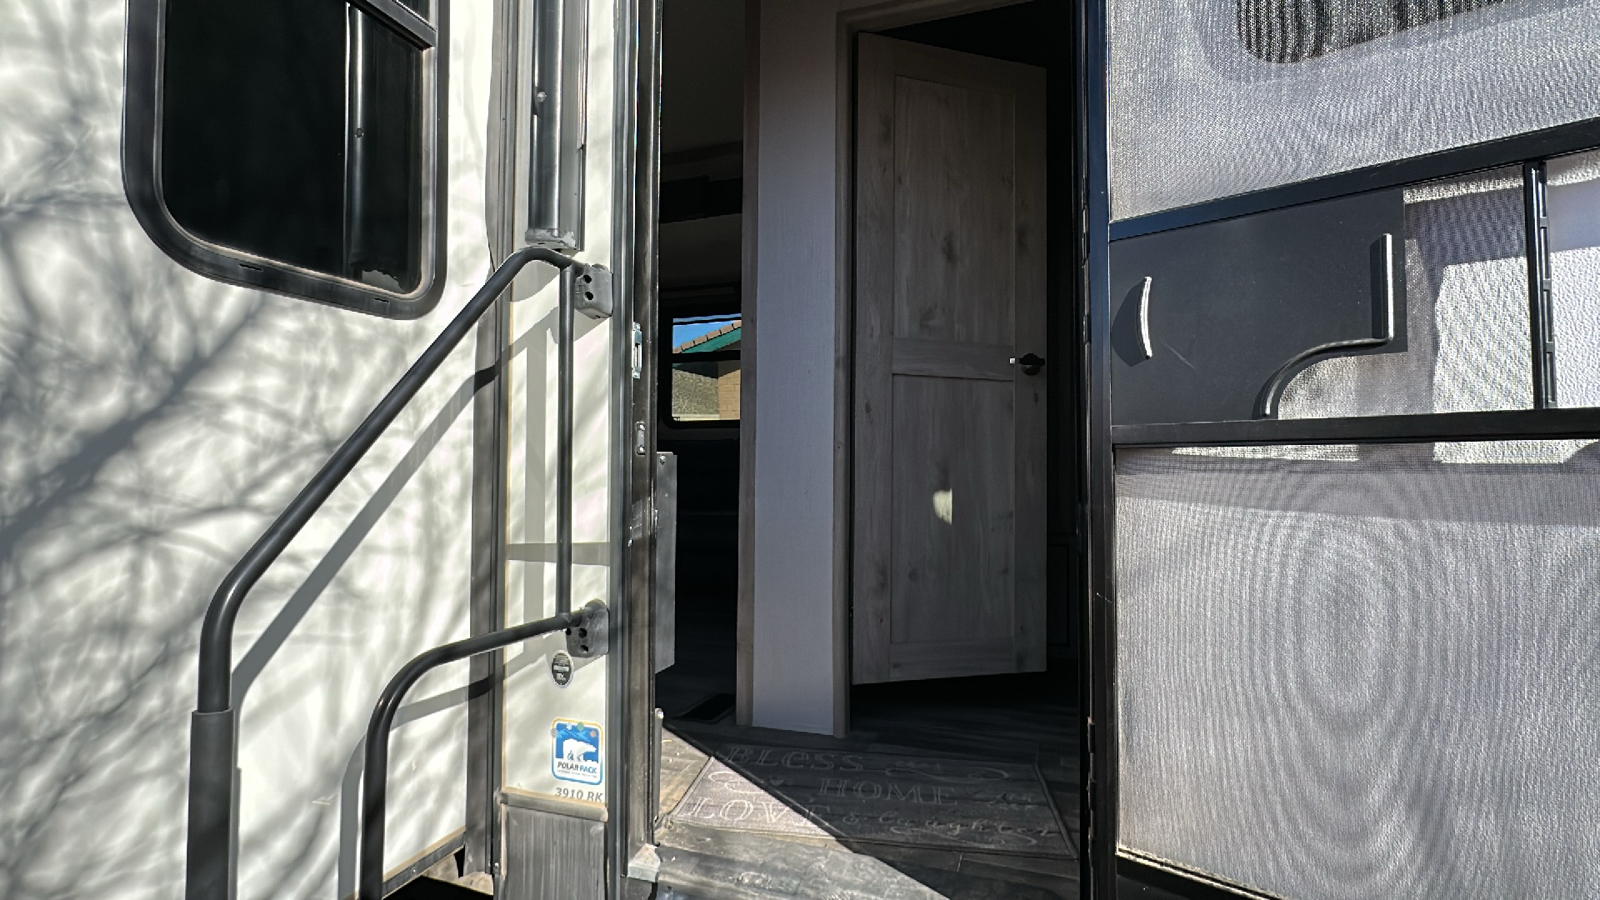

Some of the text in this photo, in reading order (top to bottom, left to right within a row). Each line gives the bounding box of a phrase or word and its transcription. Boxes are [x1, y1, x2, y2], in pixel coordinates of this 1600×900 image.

[557, 761, 579, 771] POLAR
[580, 765, 597, 774] PACK
[555, 787, 603, 802] 3910 RK
[818, 777, 958, 806] HOME
